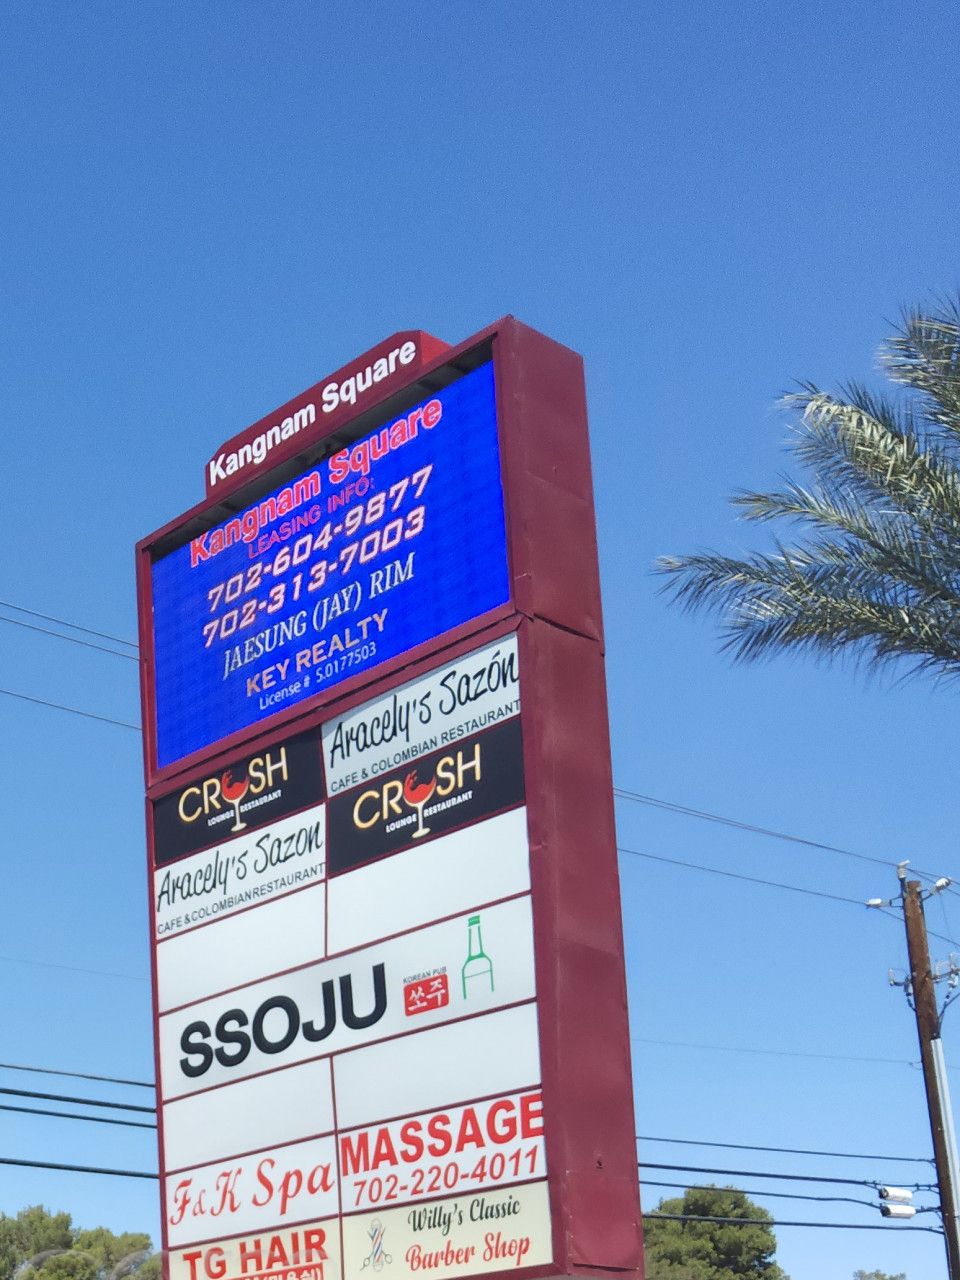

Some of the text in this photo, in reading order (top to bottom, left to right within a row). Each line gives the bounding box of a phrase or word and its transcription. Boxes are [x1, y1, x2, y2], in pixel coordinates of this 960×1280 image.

[208, 340, 417, 487] Kangnam Square
[189, 399, 443, 568] Kangnam Square
[247, 476, 376, 559] LEASING INFO:
[207, 464, 434, 612] 702-604-9877
[202, 506, 426, 648] 702-313-7003
[222, 552, 416, 681] JAESUNG (JAY) RIM
[245, 608, 389, 697] KEY REALTY
[258, 641, 377, 711] License # S.0177503
[330, 650, 520, 768] Aracely's Sazón
[330, 699, 522, 793] CAFE & COLOMBIAN RESTAURANT
[207, 789, 283, 827] LOUNGE RESTAURANT
[385, 790, 473, 834] LOUNGE RESTAURANT
[157, 850, 248, 912] Aracely's
[157, 915, 182, 935] CAFE
[183, 911, 191, 925] &
[403, 970, 431, 984] KOREAN
[407, 978, 446, 1011] 쏘주
[179, 961, 387, 1078] SSOJU
[341, 1090, 544, 1177] MASSAGE
[251, 1158, 336, 1216] Spa
[353, 1144, 539, 1207] 702-220-4011
[239, 1227, 329, 1274] HAIR
[407, 1195, 521, 1237] Willy's Classic
[405, 1232, 531, 1272] Barber Shop
